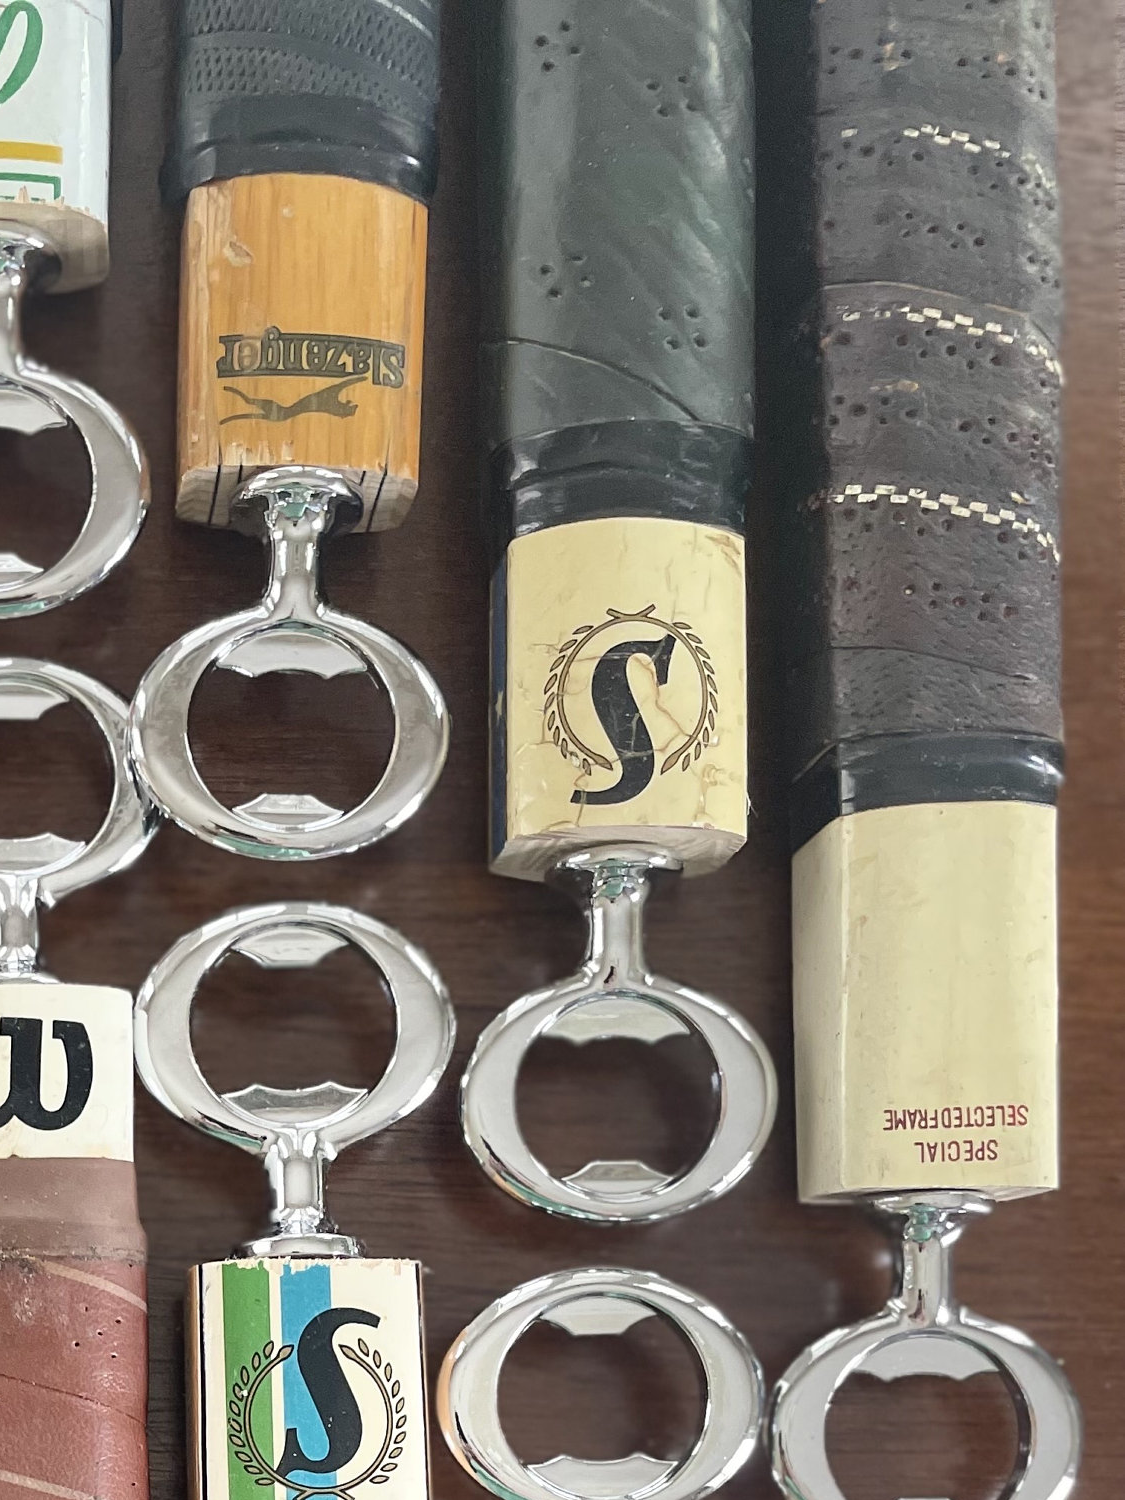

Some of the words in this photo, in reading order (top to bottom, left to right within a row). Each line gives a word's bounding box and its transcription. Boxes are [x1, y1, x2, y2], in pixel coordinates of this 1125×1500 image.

[216, 326, 406, 388] Slazenger
[570, 634, 676, 804] S
[882, 1108, 938, 1131] FRAME
[941, 1104, 1029, 1129] SELECTED
[914, 1139, 998, 1163] SPECIAL
[276, 1306, 380, 1475] S
